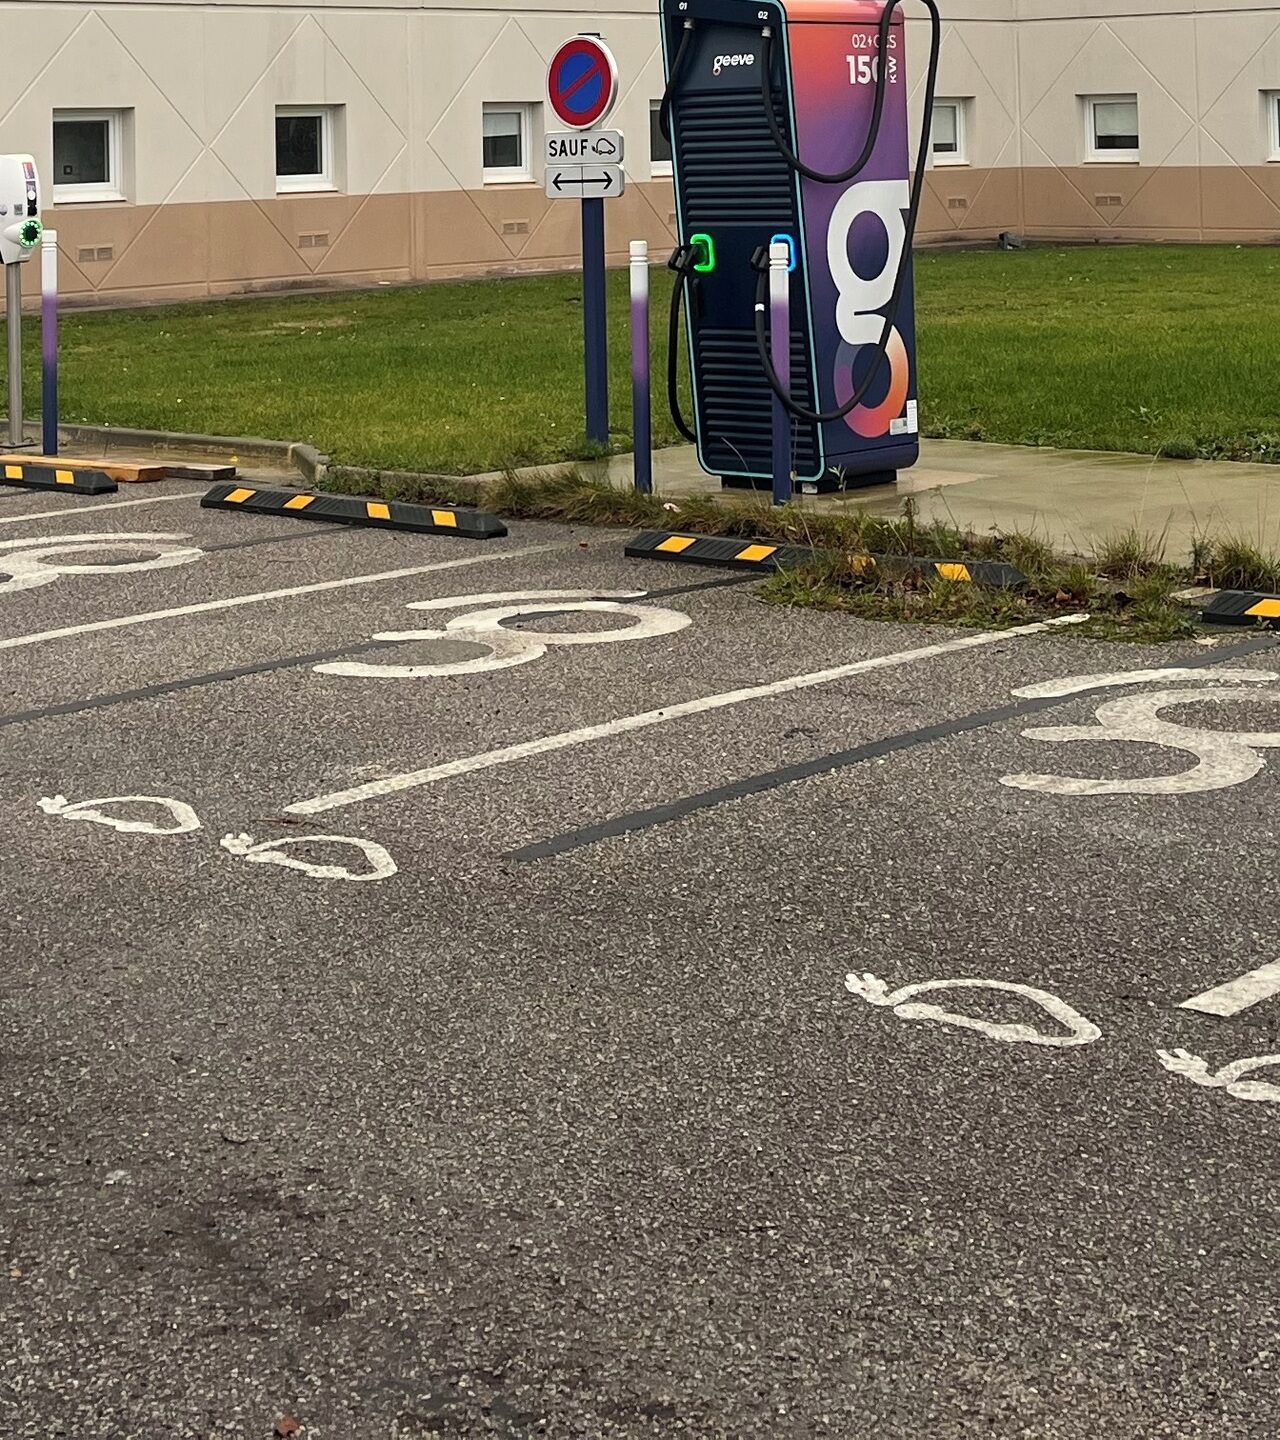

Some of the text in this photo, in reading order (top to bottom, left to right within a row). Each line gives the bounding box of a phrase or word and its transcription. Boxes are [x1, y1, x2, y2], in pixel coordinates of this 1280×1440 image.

[873, 34, 897, 49] CS
[713, 53, 755, 76] geeve
[549, 139, 589, 157] SAUF
